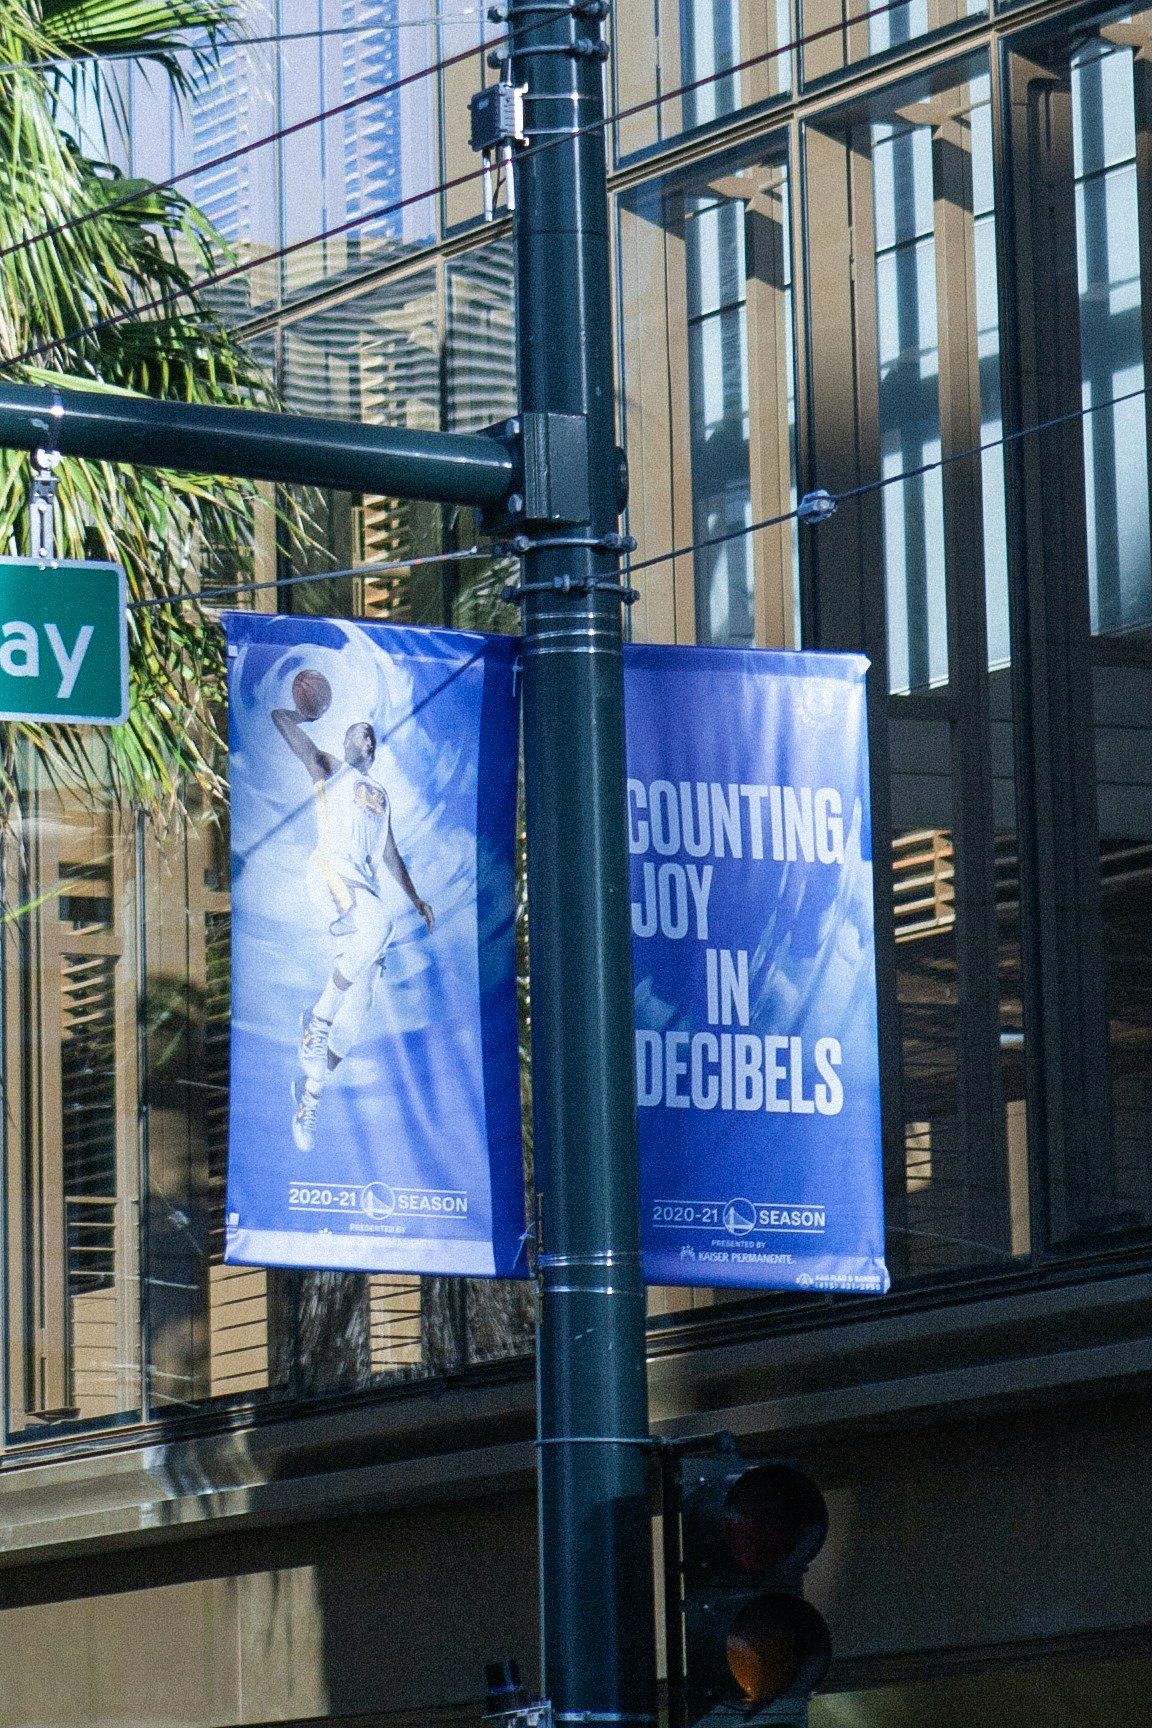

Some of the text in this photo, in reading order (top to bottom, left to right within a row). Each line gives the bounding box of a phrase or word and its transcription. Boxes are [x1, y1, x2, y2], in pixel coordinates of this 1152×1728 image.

[627, 778, 845, 865] COUNTING
[631, 862, 714, 940] JOY
[706, 949, 750, 1027] IN
[636, 1028, 844, 1116] DECIBELS
[288, 1188, 468, 1213] 2020-21 SEASON
[652, 1206, 826, 1227] 2020-21 SEASON
[698, 1251, 729, 1263] KAISER
[711, 1239, 766, 1249] PRESENTED BY
